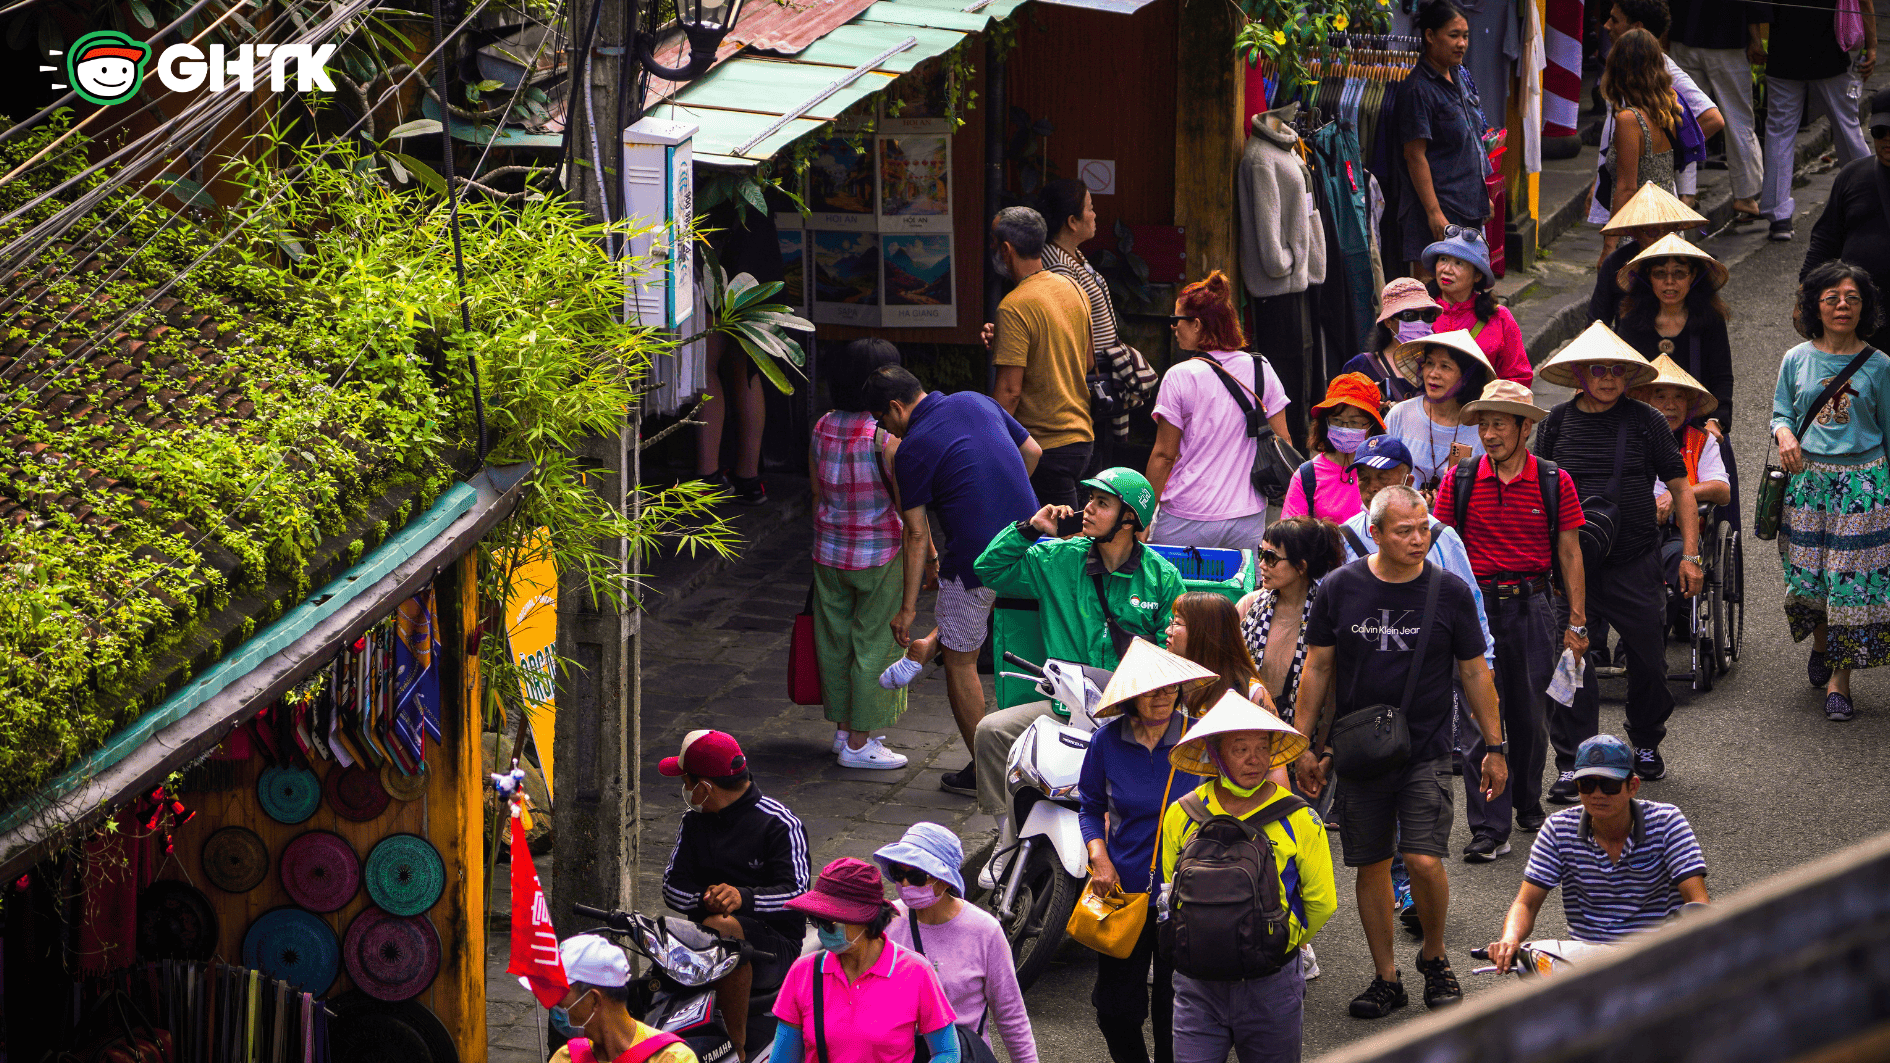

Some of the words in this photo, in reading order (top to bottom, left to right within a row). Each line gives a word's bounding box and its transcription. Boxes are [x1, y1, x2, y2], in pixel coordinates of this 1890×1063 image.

[912, 309, 939, 318] GIANG
[1351, 624, 1378, 634] Calvin
[1379, 625, 1399, 635] Klein
[702, 1040, 733, 1063] YAMAHA
